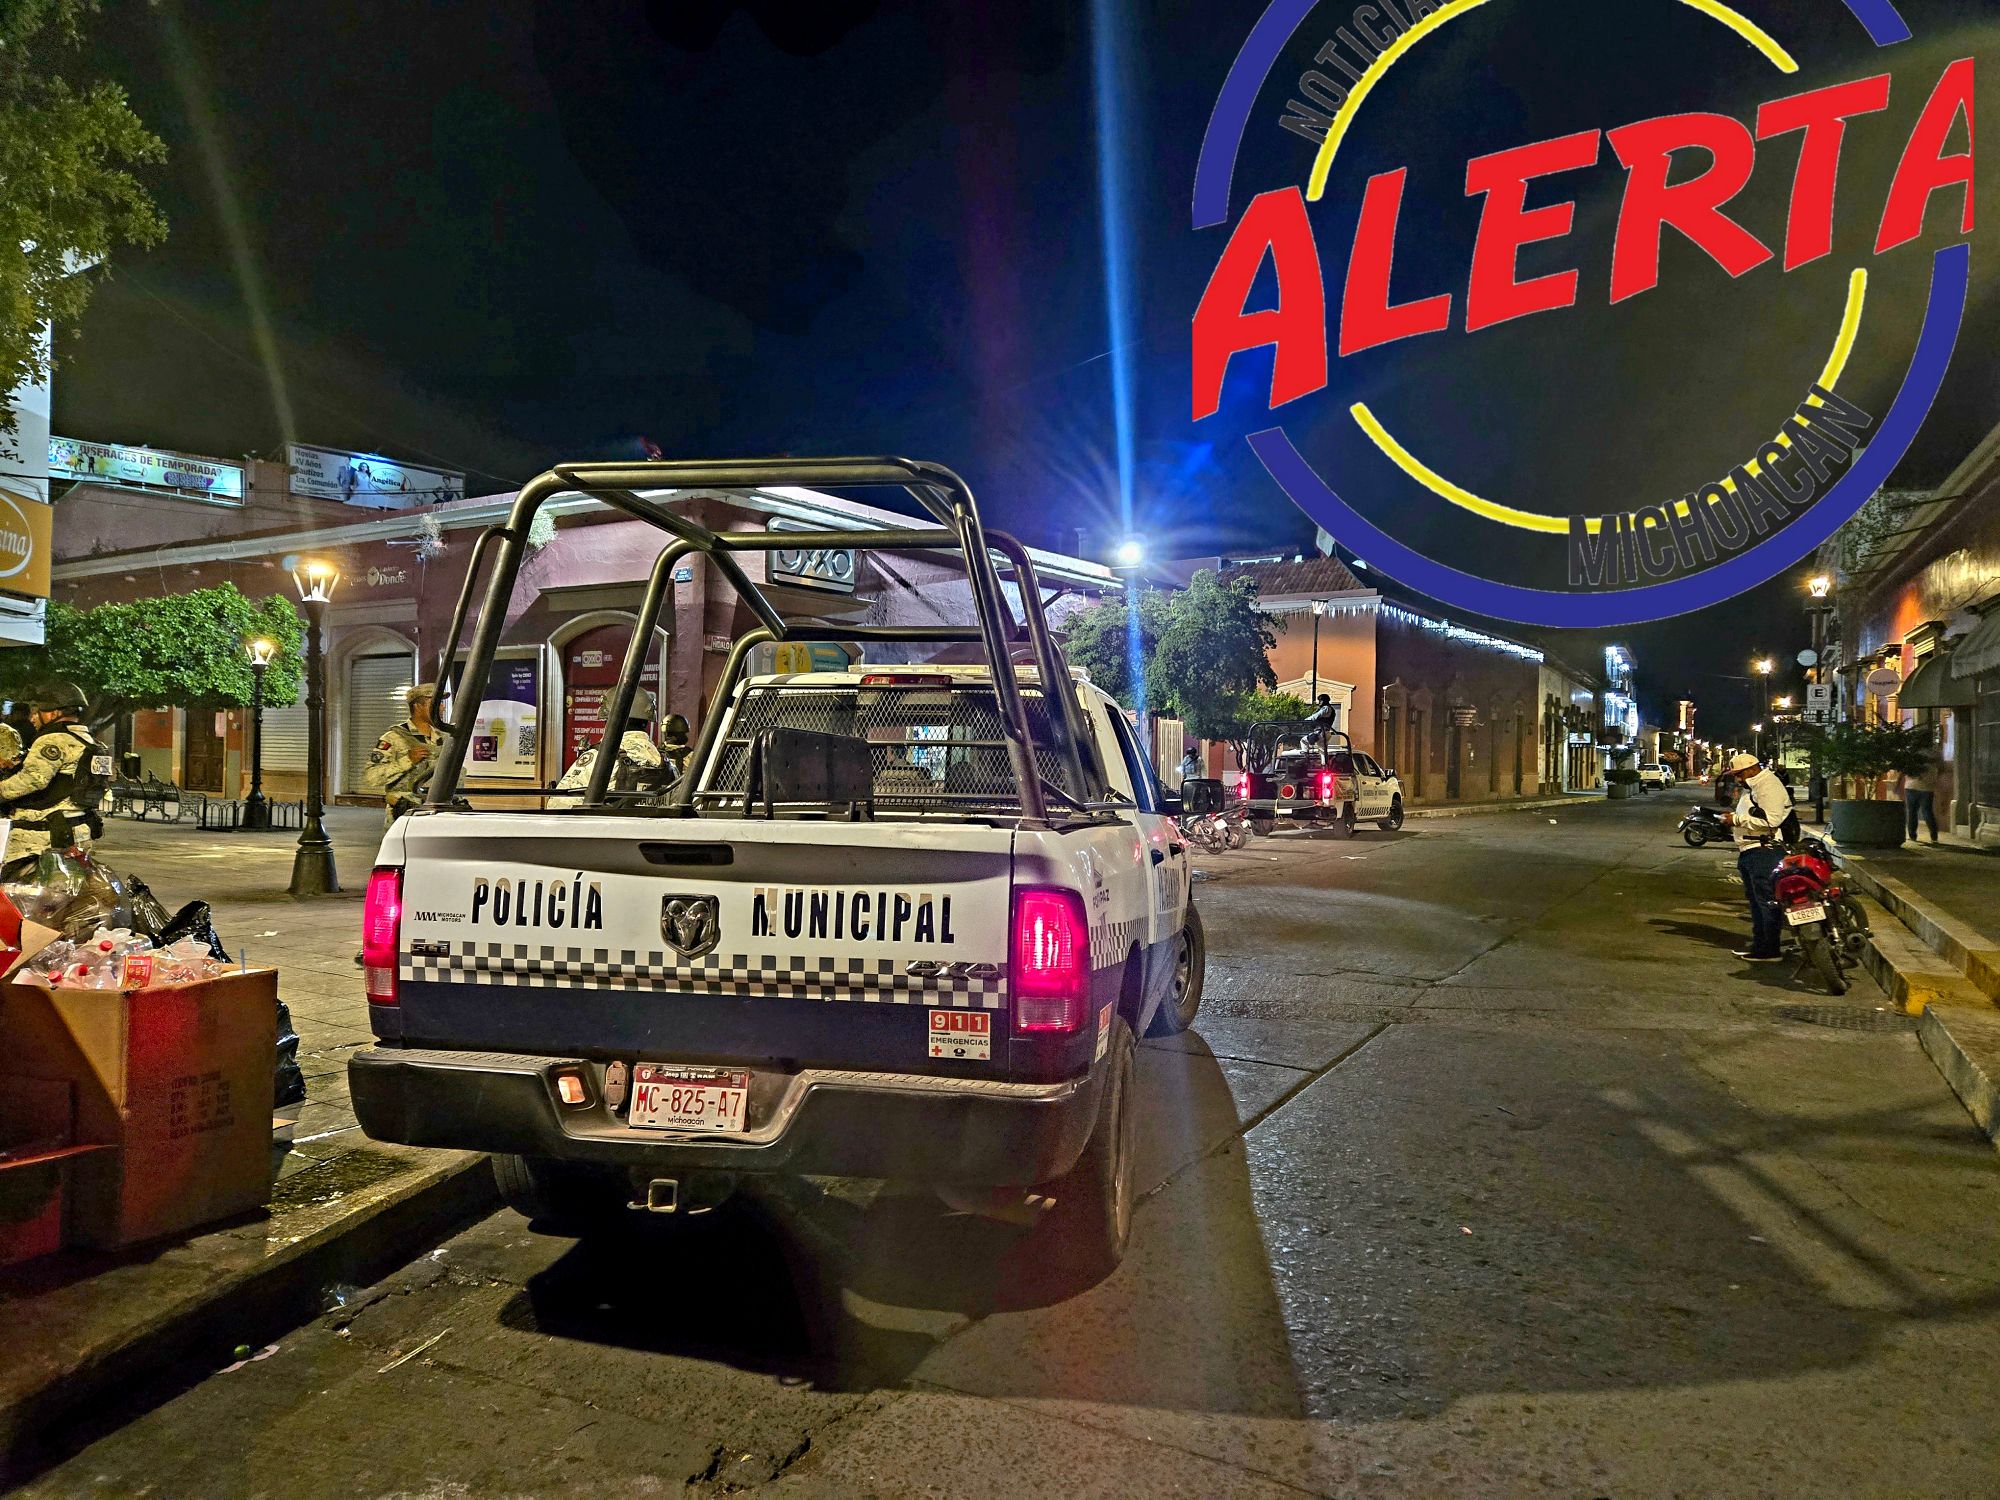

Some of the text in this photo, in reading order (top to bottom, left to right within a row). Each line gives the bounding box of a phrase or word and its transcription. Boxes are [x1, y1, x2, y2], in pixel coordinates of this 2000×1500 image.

[140, 456, 153, 465] DE
[1815, 688, 1823, 698] E
[472, 872, 603, 929] POLICÍA
[752, 888, 955, 944] MUNICIPAL
[933, 1013, 983, 1031] 911
[930, 1036, 989, 1047] EMERGENCIAS
[635, 1085, 741, 1117] MC-825-A7
[667, 1115, 705, 1126] Michoacán
